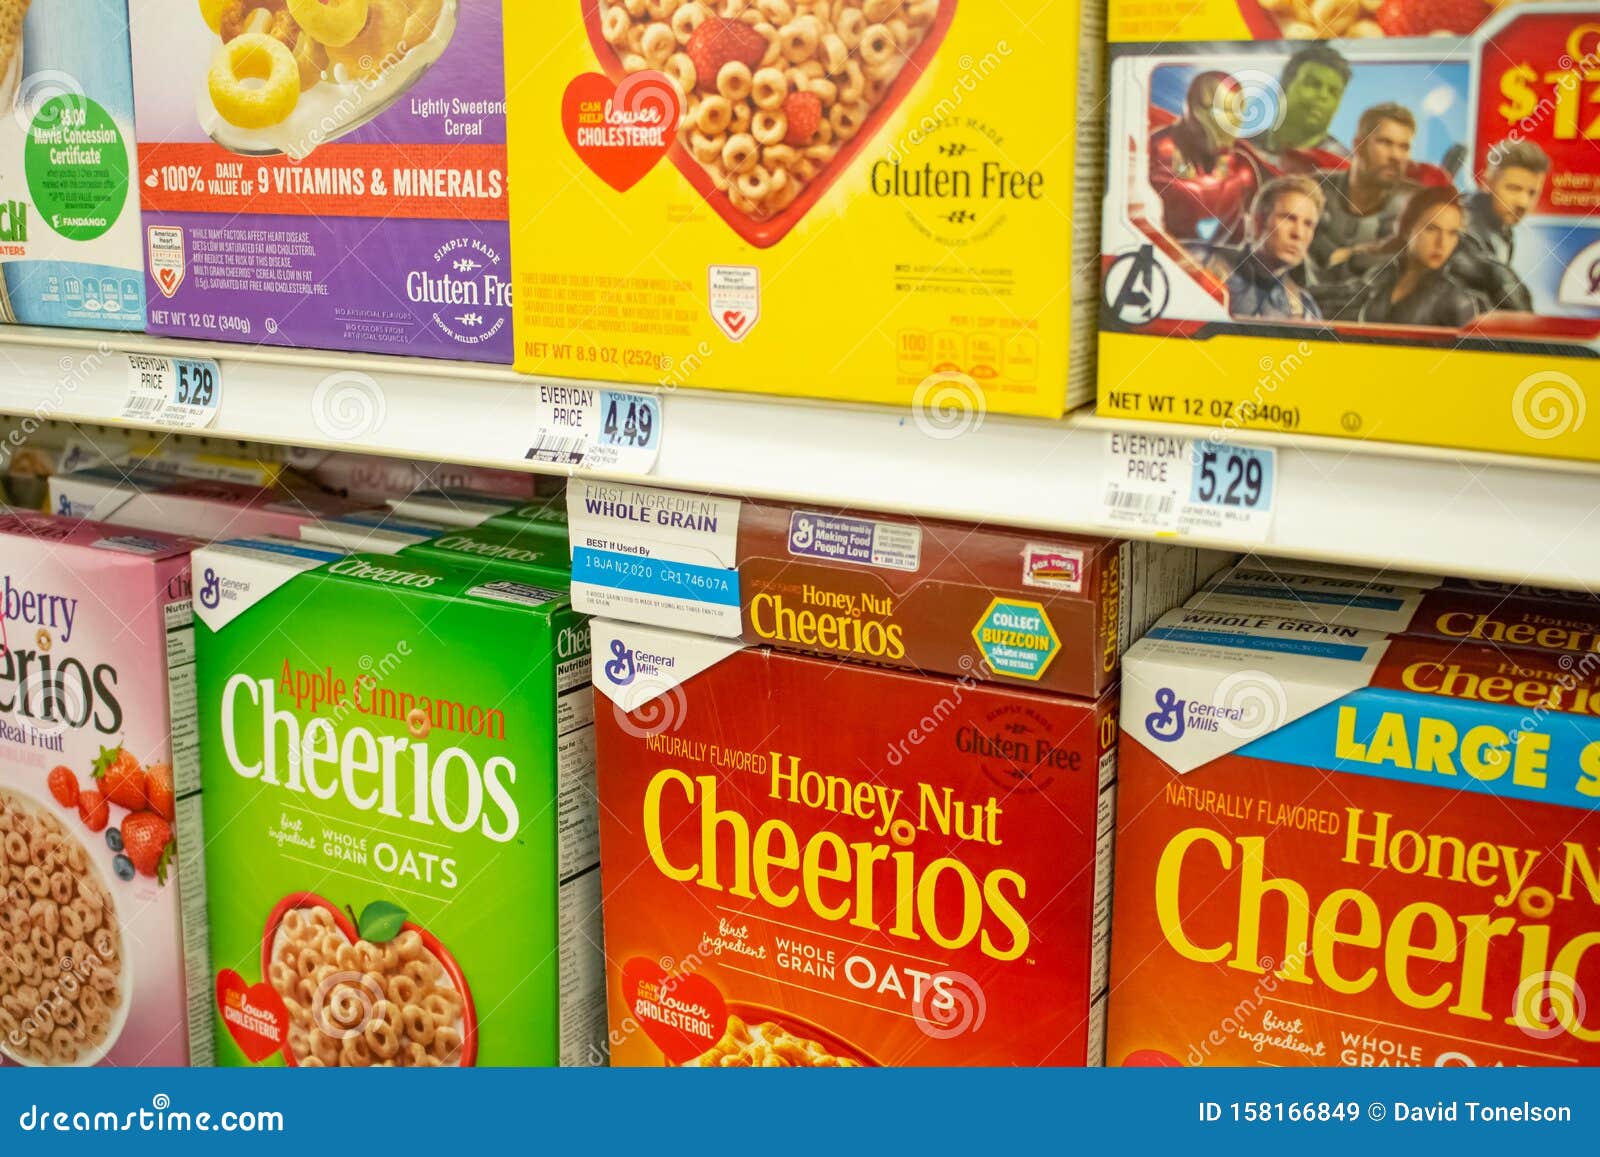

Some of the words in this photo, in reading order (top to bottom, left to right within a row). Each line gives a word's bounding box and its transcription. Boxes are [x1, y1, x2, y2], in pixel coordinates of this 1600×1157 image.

[411, 98, 450, 118] Lightly
[579, 113, 603, 123] HELP
[604, 99, 661, 125] lower
[580, 102, 600, 112] CAN
[34, 126, 62, 144] Movie
[63, 123, 117, 144] Concession
[445, 119, 482, 136] Cereal
[577, 126, 666, 147] CHOLESTEROL
[161, 166, 204, 193] 100%
[216, 163, 243, 179] DAILY
[208, 180, 238, 195] VALUE
[241, 181, 254, 196] OF
[257, 167, 269, 194] 9
[273, 168, 364, 195] VITAMINS
[371, 167, 387, 196] &
[394, 169, 502, 198] MINERALS
[871, 160, 970, 198] Gluten
[982, 162, 1044, 200] Free
[62, 217, 107, 227] FANDANGO
[434, 239, 469, 262] SIMPLY
[472, 239, 501, 265] MADE
[407, 271, 481, 306] Gluten
[152, 310, 169, 324] NET
[172, 312, 187, 326] WT
[189, 313, 199, 327] 12
[203, 315, 216, 329] OZ
[218, 316, 250, 335] (340g)
[454, 332, 479, 343] MILLED
[480, 317, 505, 342] TOASTED
[128, 355, 169, 372] EVERYDAY
[525, 342, 548, 358] NET
[552, 343, 571, 360] WT
[577, 346, 597, 362] 8.9
[600, 348, 618, 364] OZ
[141, 373, 162, 389] PRICE
[179, 365, 213, 406] 5.29
[540, 386, 594, 407] EVERYDAY
[1109, 391, 1142, 409] NET
[1148, 396, 1175, 414] WT
[1183, 398, 1204, 416] 12
[1210, 400, 1234, 419] OZ
[1240, 402, 1300, 428] (340g)
[553, 408, 583, 427] PRICE
[604, 400, 652, 447] 4.49
[1111, 434, 1186, 460] EVERYDAY
[1127, 459, 1168, 482] PRICE
[1199, 452, 1263, 507] 5.29
[584, 485, 626, 501] FIRST
[631, 491, 720, 516] INGREDIENT
[585, 499, 651, 523] WHOLE
[657, 509, 718, 533] GRAIN
[433, 536, 545, 562] Cheerios
[586, 538, 607, 549] BEST
[609, 541, 616, 550] If
[616, 542, 638, 553] Used
[639, 544, 650, 556] By
[814, 540, 845, 555] People
[847, 545, 870, 558] Love
[816, 529, 848, 544] Making
[850, 534, 870, 546] Food
[221, 578, 250, 592] General
[328, 560, 444, 589] Cheerios
[221, 589, 238, 601] Mills
[802, 584, 856, 616] Honey
[861, 593, 893, 616] Nut
[750, 593, 905, 660] Cheerios
[993, 613, 1040, 631] COLLECT
[1182, 613, 1269, 630] WHOLE
[1277, 621, 1360, 638] GRAIN
[982, 628, 1049, 651] BUZZCOIN
[635, 650, 675, 668] General
[636, 662, 659, 677] Mills
[279, 657, 346, 713] Apple
[354, 675, 505, 740] Cinnamon
[1188, 701, 1244, 722] General
[1187, 716, 1219, 732] Mills
[31, 727, 64, 752] Fruit
[956, 726, 1028, 763] Gluten
[1036, 740, 1082, 771] Free
[1335, 705, 1551, 789] LARGE
[221, 673, 519, 843] Cheerios
[645, 731, 707, 762] NATURALLY
[710, 745, 767, 775] FLAVORED
[769, 751, 903, 836] Honey
[917, 782, 1002, 846] Nut
[268, 826, 316, 849] ingredient
[322, 828, 367, 850] WHOLE
[1166, 782, 1251, 820] NATURALLY
[1258, 800, 1340, 836] FLAVORED
[1342, 807, 1541, 908] Honey
[323, 842, 367, 866] GRAIN
[373, 842, 458, 889] OATS
[643, 768, 1030, 961] Cheerios
[719, 918, 749, 939] first
[702, 933, 767, 960] ingredient
[776, 937, 836, 966] WHOLE
[638, 980, 657, 993] CAN
[776, 953, 836, 981] GRAIN
[844, 955, 955, 1011] OATS
[659, 986, 710, 1019] lower
[224, 1005, 281, 1043] CHOLESTEROL
[635, 999, 714, 1040] CHOLESTEROL
[1263, 1010, 1304, 1034] first
[1237, 1025, 1327, 1058] ingredient
[1340, 1031, 1423, 1062] WHOLE
